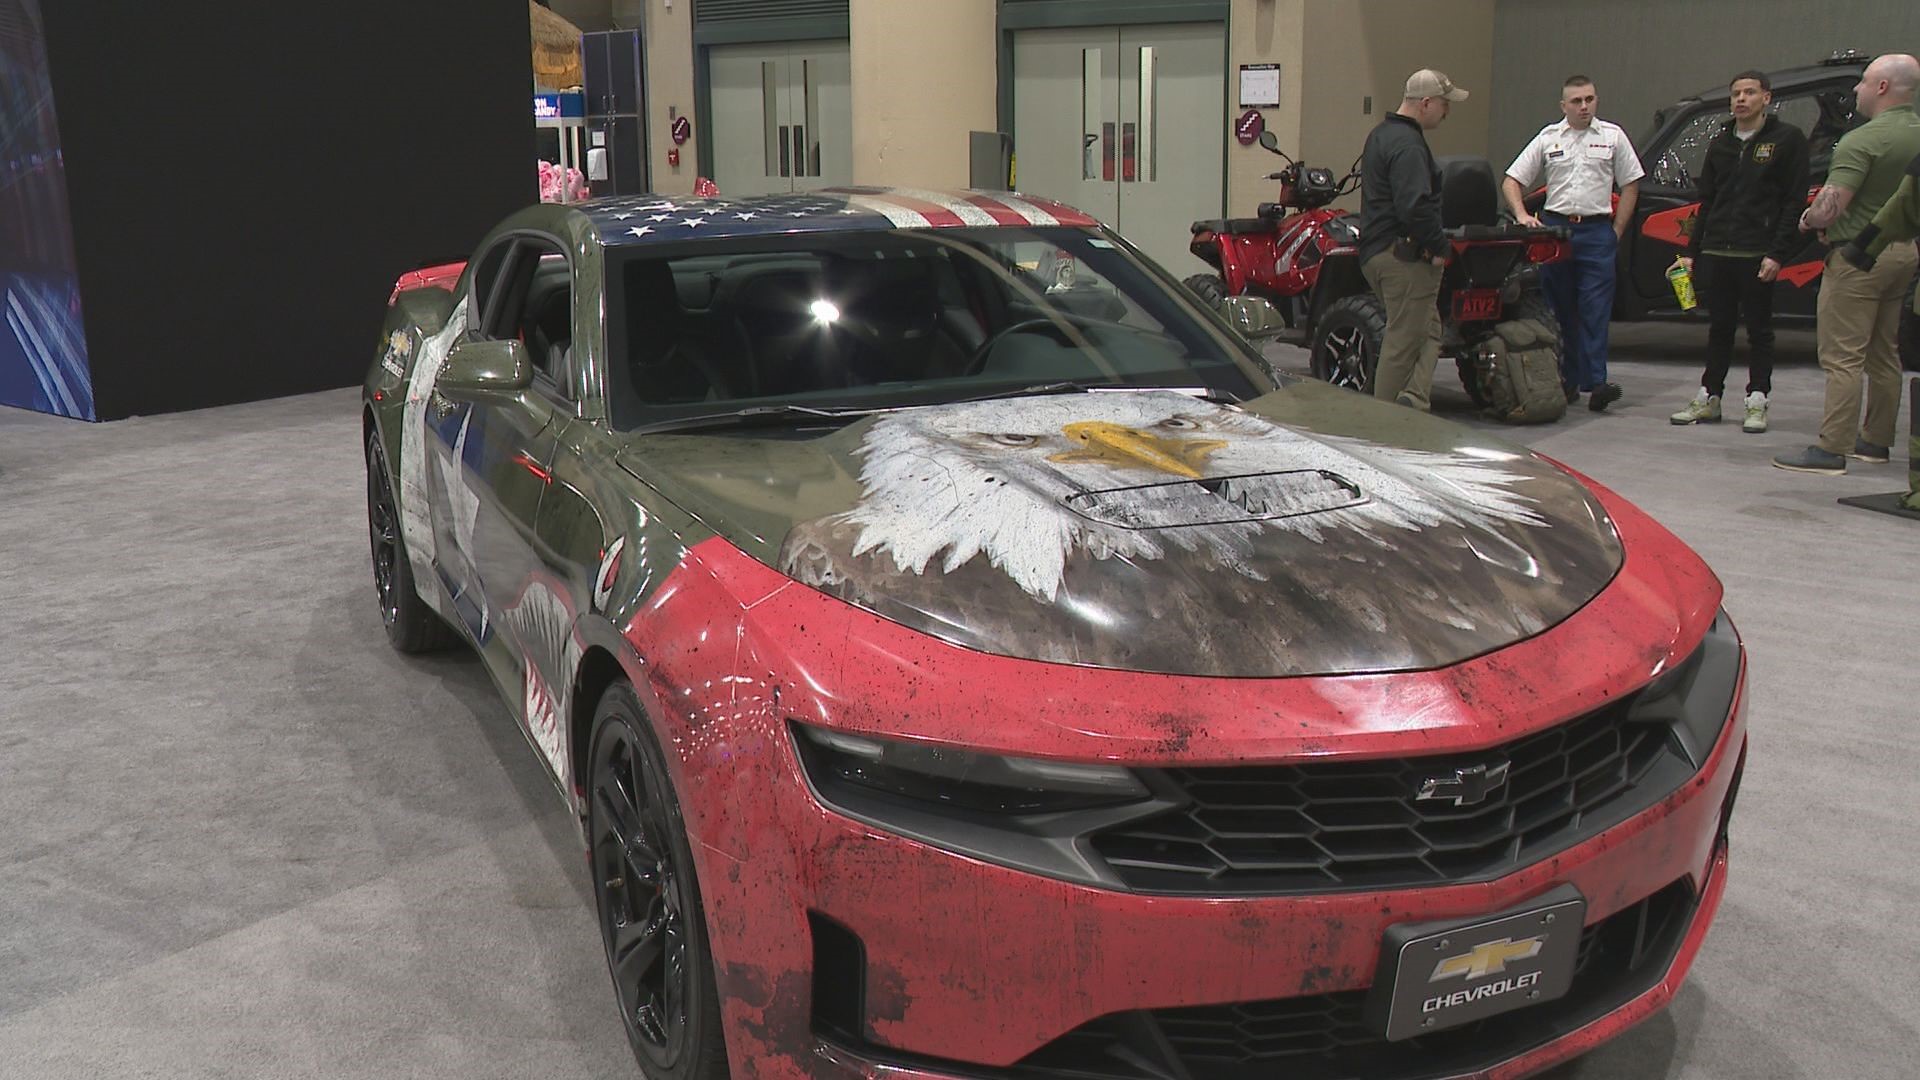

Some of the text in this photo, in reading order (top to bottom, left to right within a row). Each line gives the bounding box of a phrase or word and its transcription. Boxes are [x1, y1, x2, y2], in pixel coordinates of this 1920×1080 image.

[534, 98, 547, 107] ON
[534, 106, 557, 116] ANDY
[1462, 297, 1496, 313] ATV2
[1422, 971, 1543, 1014] CHEVROLET
